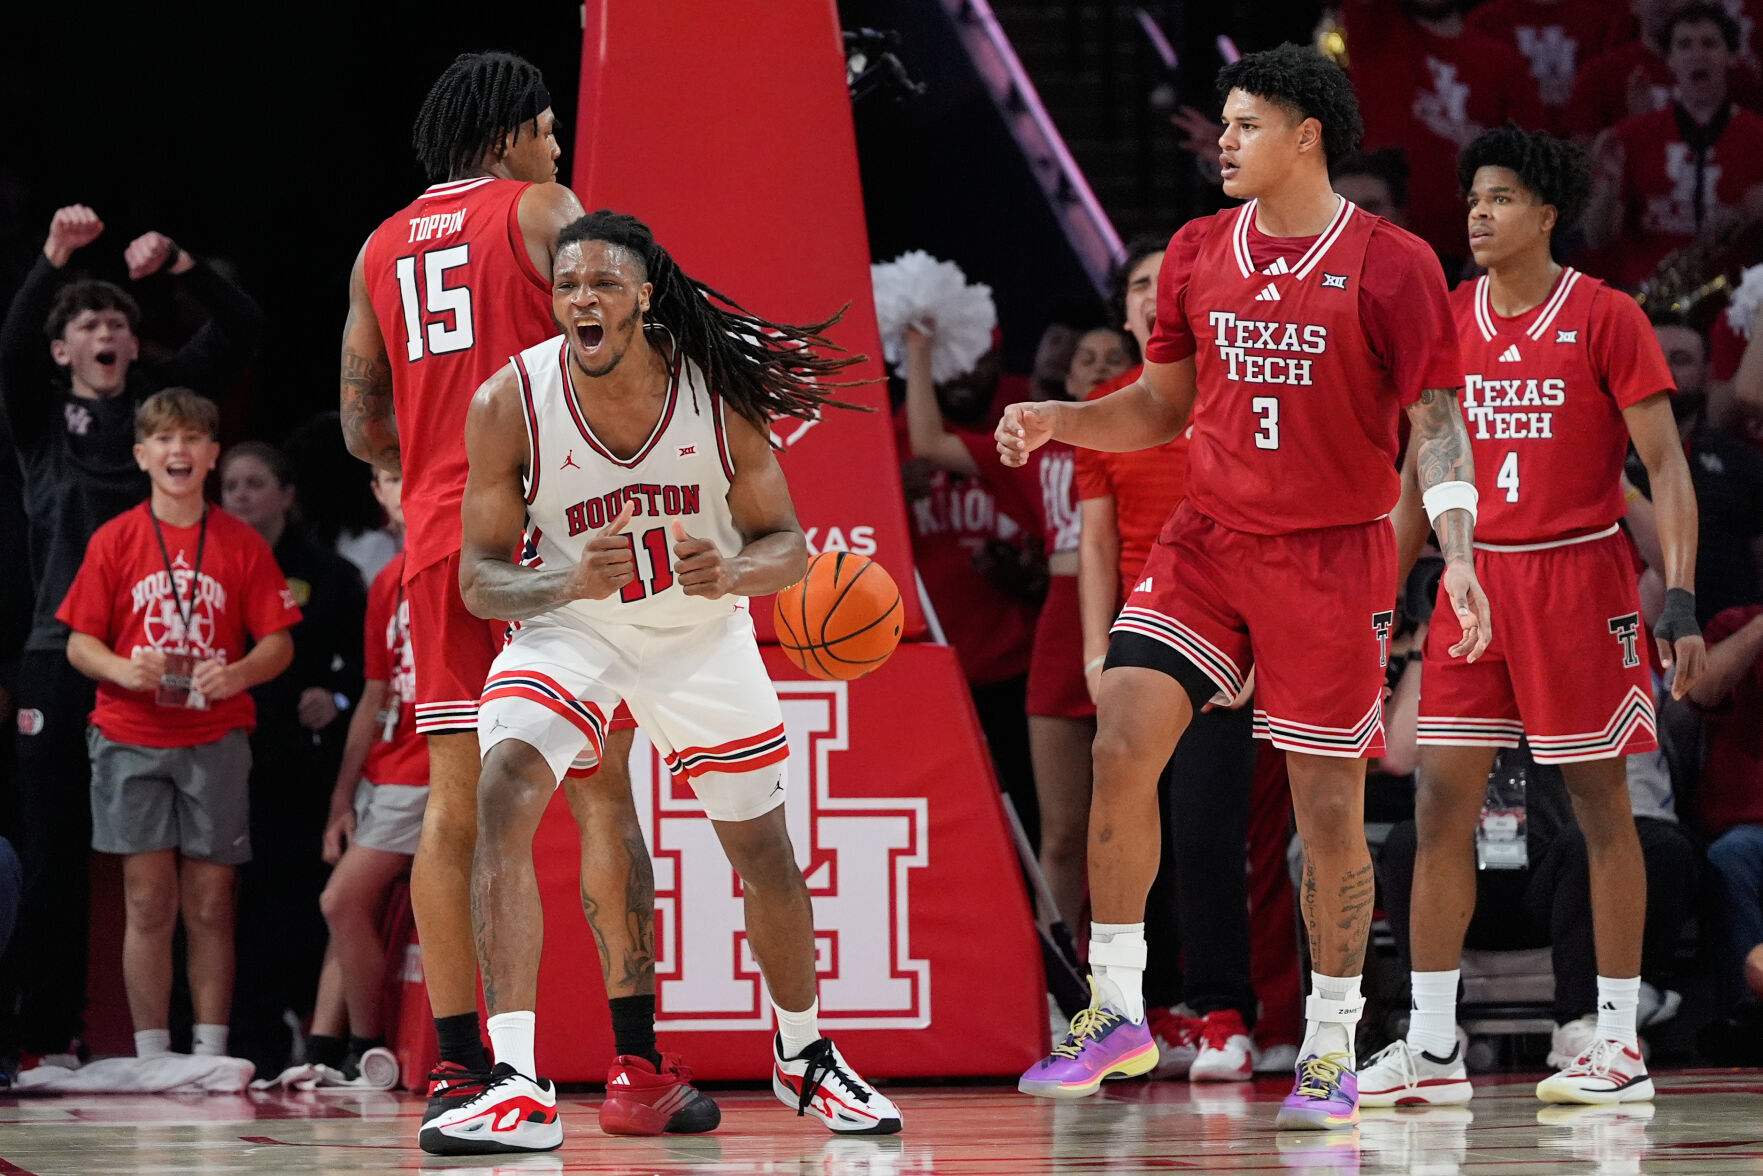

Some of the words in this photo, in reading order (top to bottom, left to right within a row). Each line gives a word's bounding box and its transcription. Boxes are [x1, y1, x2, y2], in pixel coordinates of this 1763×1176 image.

[408, 208, 467, 243] TOPPIN
[396, 242, 475, 363] 15
[1209, 311, 1327, 354] TEXAS
[1219, 346, 1314, 386] TECH
[1463, 374, 1566, 408] TEXAS
[1252, 395, 1280, 450] 3
[1467, 405, 1554, 440] TECH
[1496, 450, 1520, 503] 4
[565, 483, 700, 537] HOUSTON
[805, 525, 877, 556] XAS
[619, 526, 674, 604] 11
